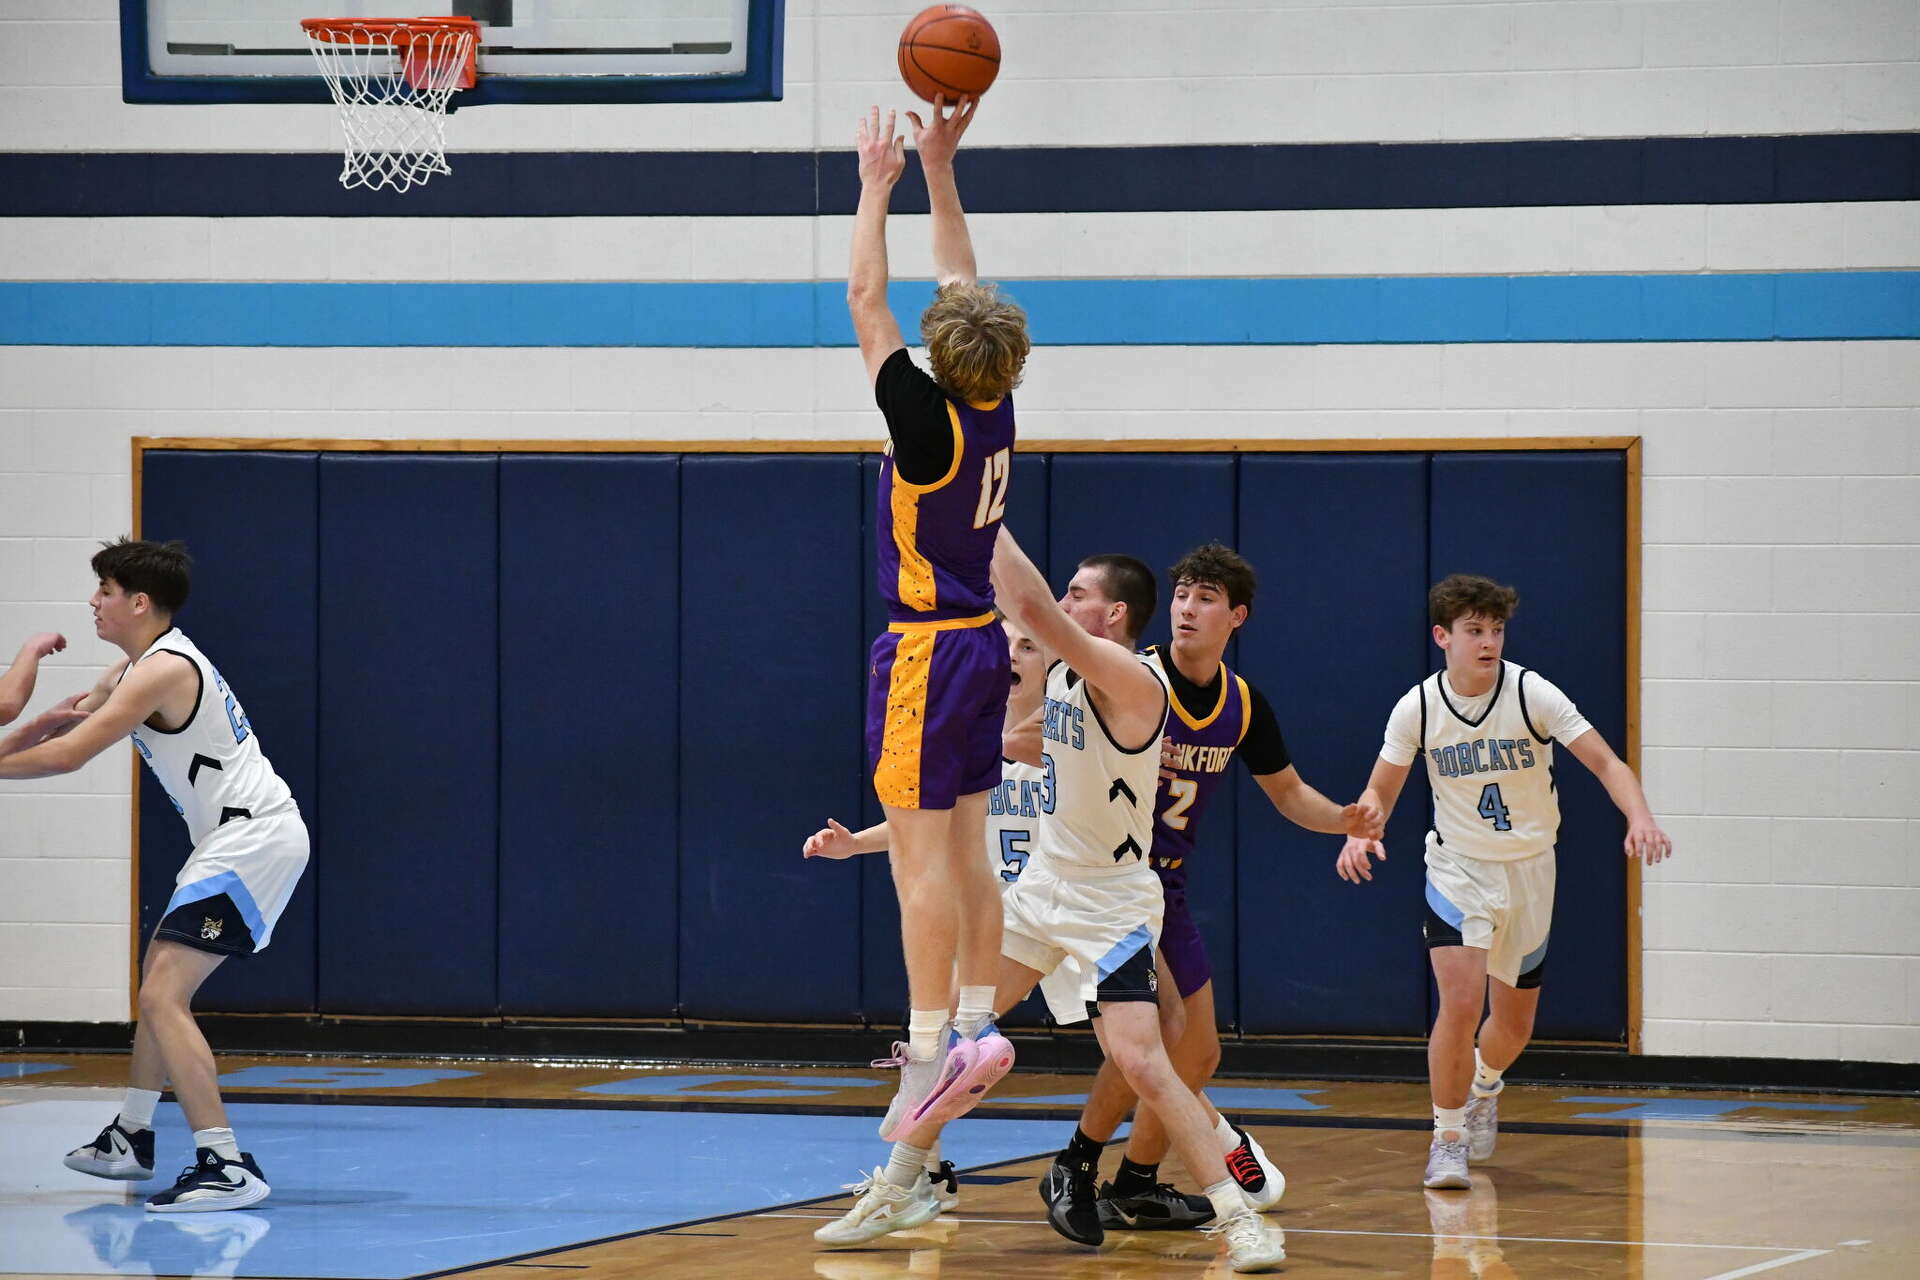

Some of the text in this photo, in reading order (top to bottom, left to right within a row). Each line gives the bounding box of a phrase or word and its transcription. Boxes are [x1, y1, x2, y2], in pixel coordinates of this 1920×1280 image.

[973, 447, 1010, 530] 12
[1430, 738, 1536, 778] BOBCATS
[1161, 778, 1199, 831] 2
[1477, 782, 1512, 831] 4
[1000, 829, 1031, 882] 5
